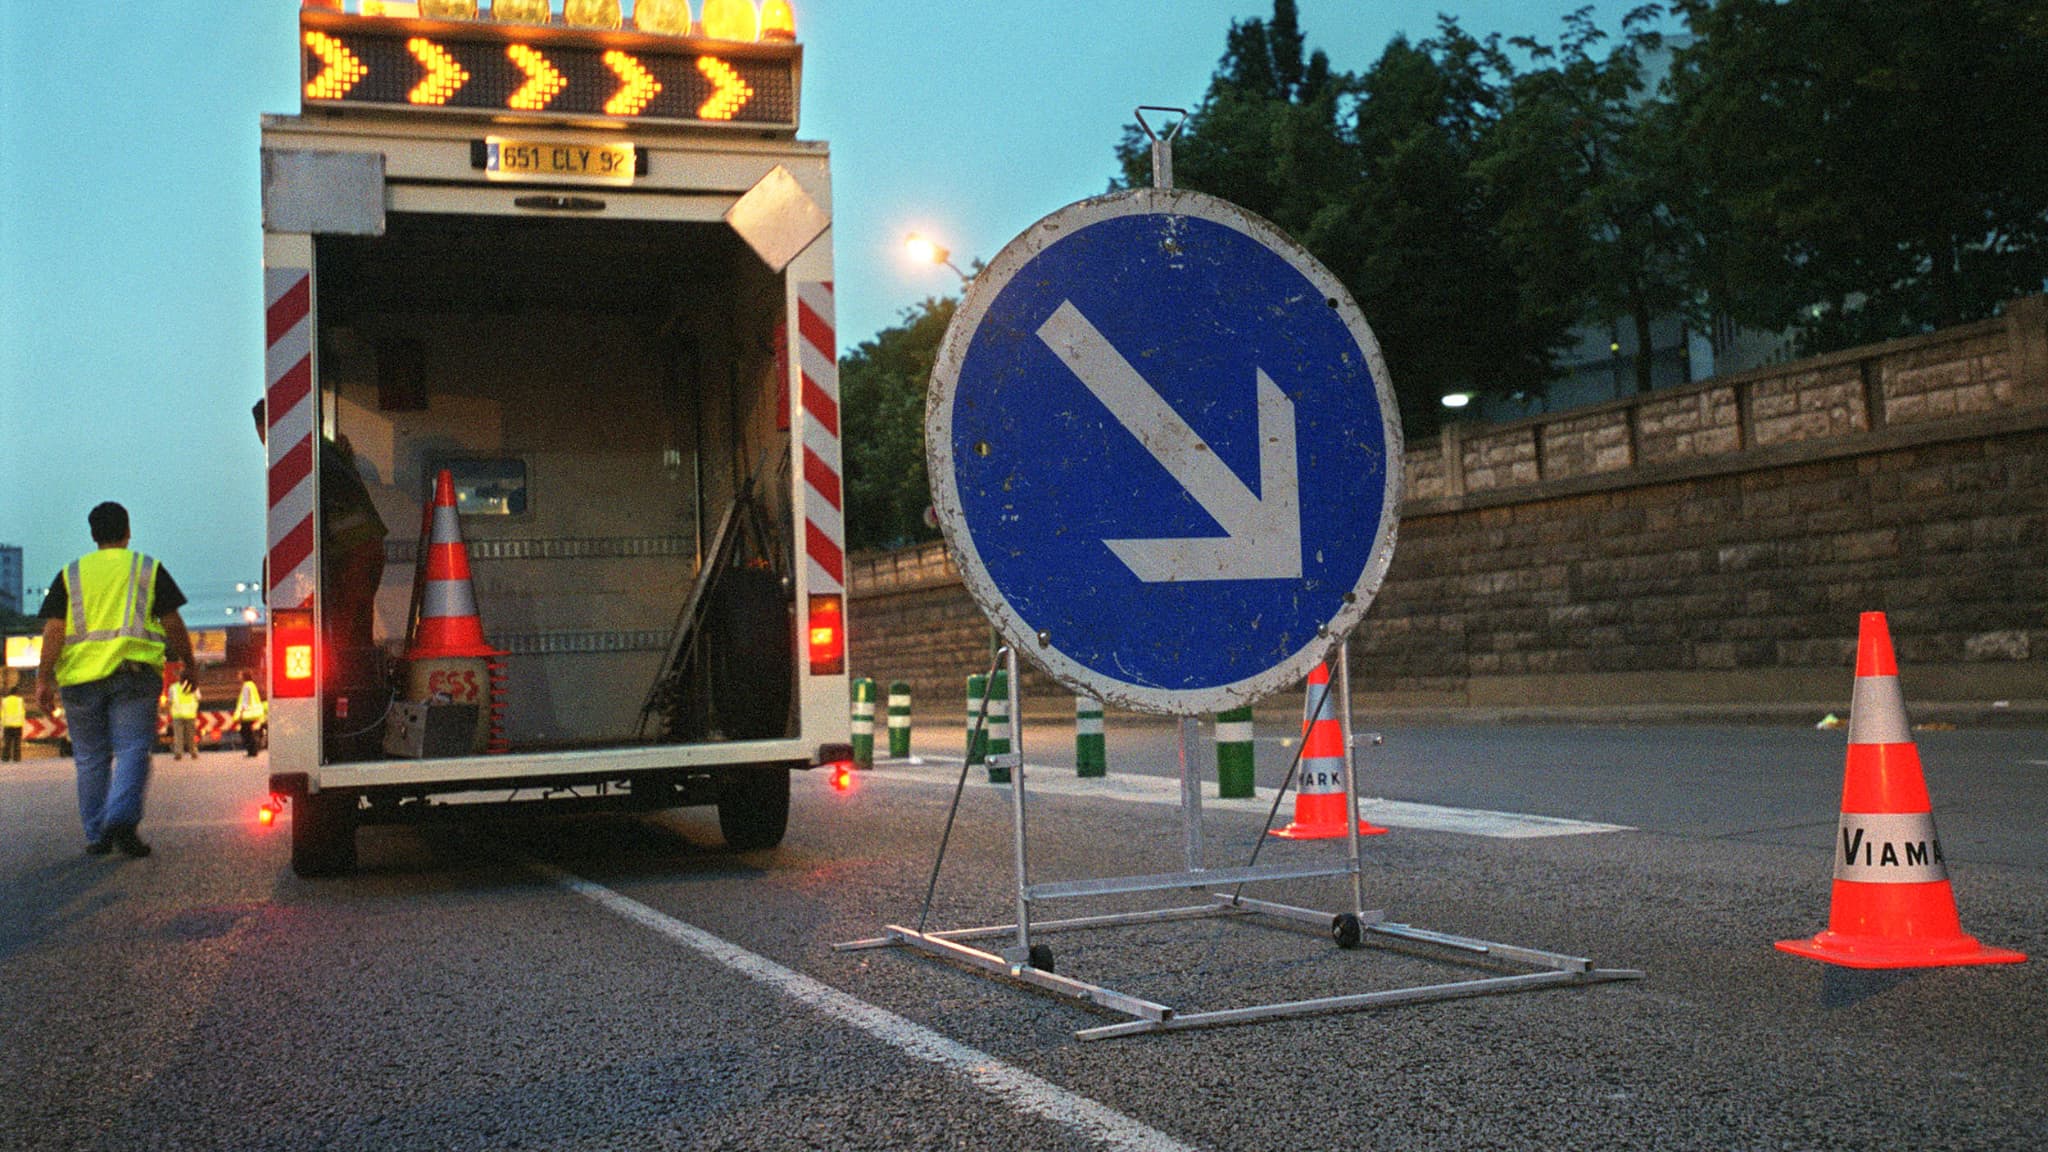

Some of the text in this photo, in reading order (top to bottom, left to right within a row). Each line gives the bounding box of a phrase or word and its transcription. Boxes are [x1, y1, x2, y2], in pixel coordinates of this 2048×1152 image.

[504, 146, 625, 173] 651 CLY 92
